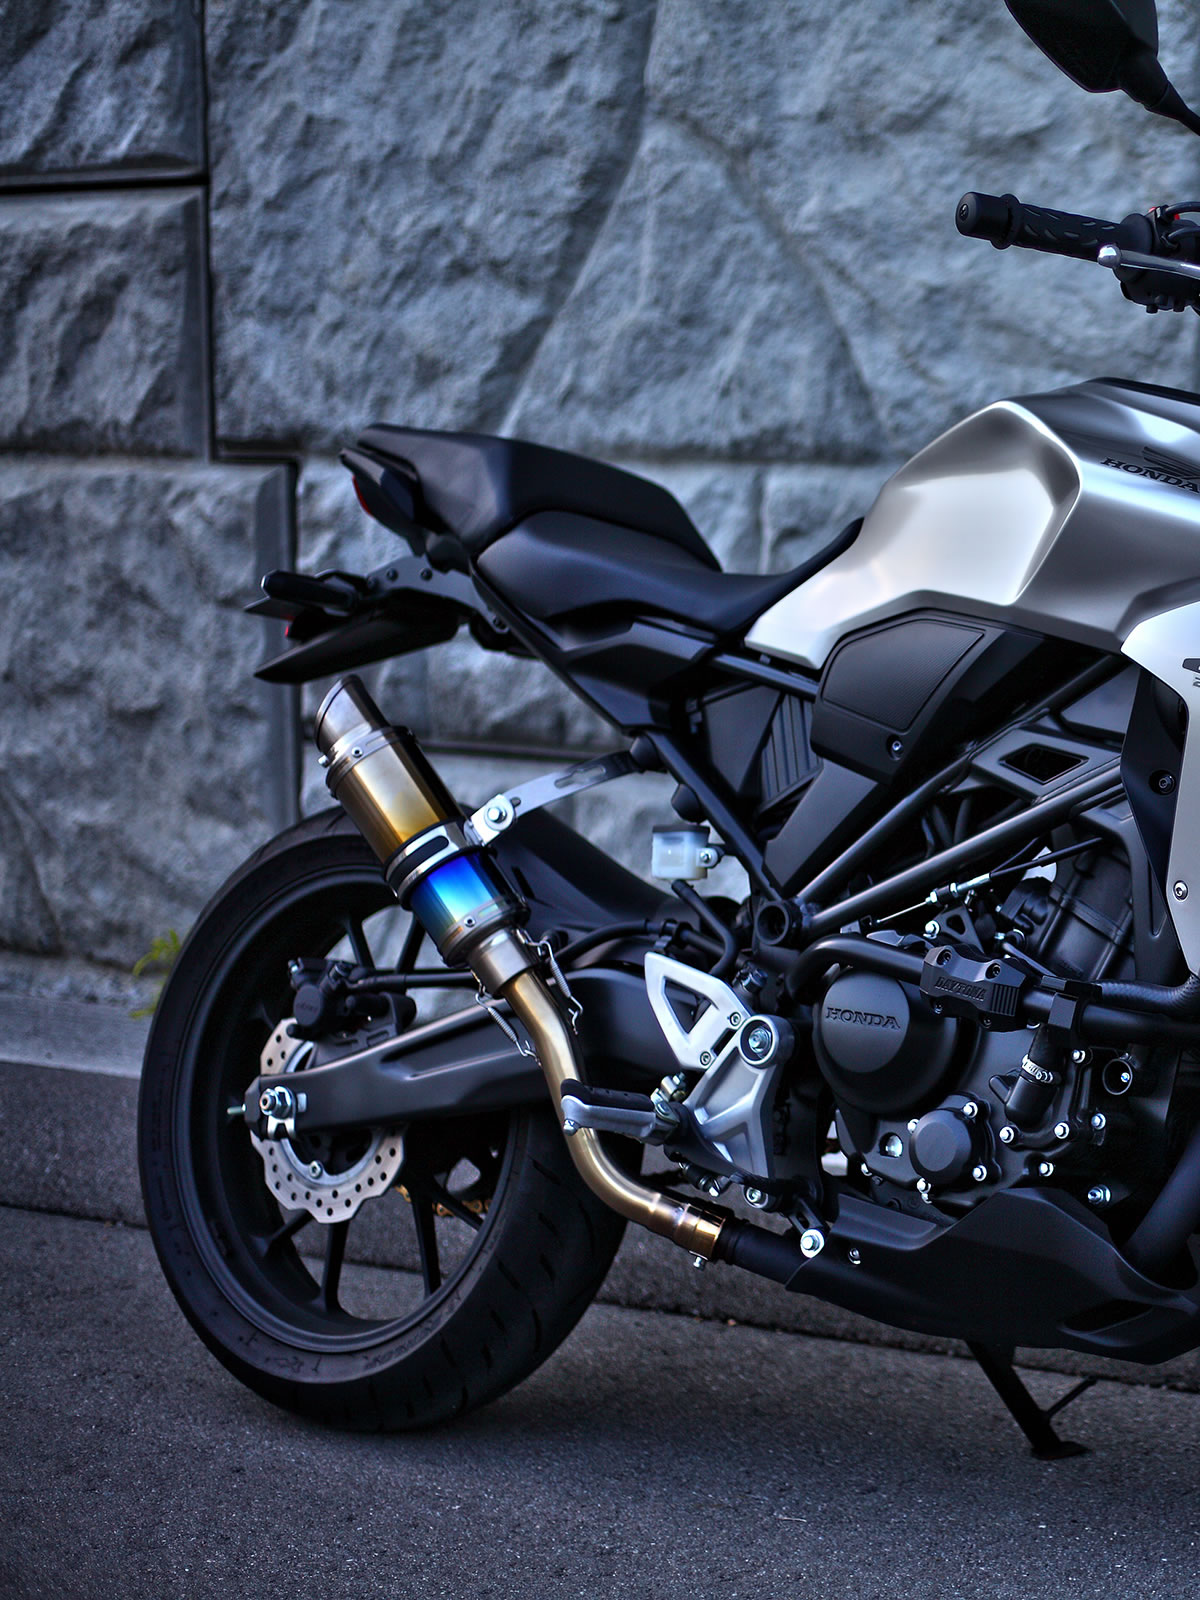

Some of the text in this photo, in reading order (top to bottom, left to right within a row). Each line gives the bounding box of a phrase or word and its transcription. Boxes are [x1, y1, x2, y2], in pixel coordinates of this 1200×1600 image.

[1100, 457, 1200, 493] HONDA
[934, 976, 987, 1002] DAYTONA
[826, 1007, 901, 1030] HONDA
